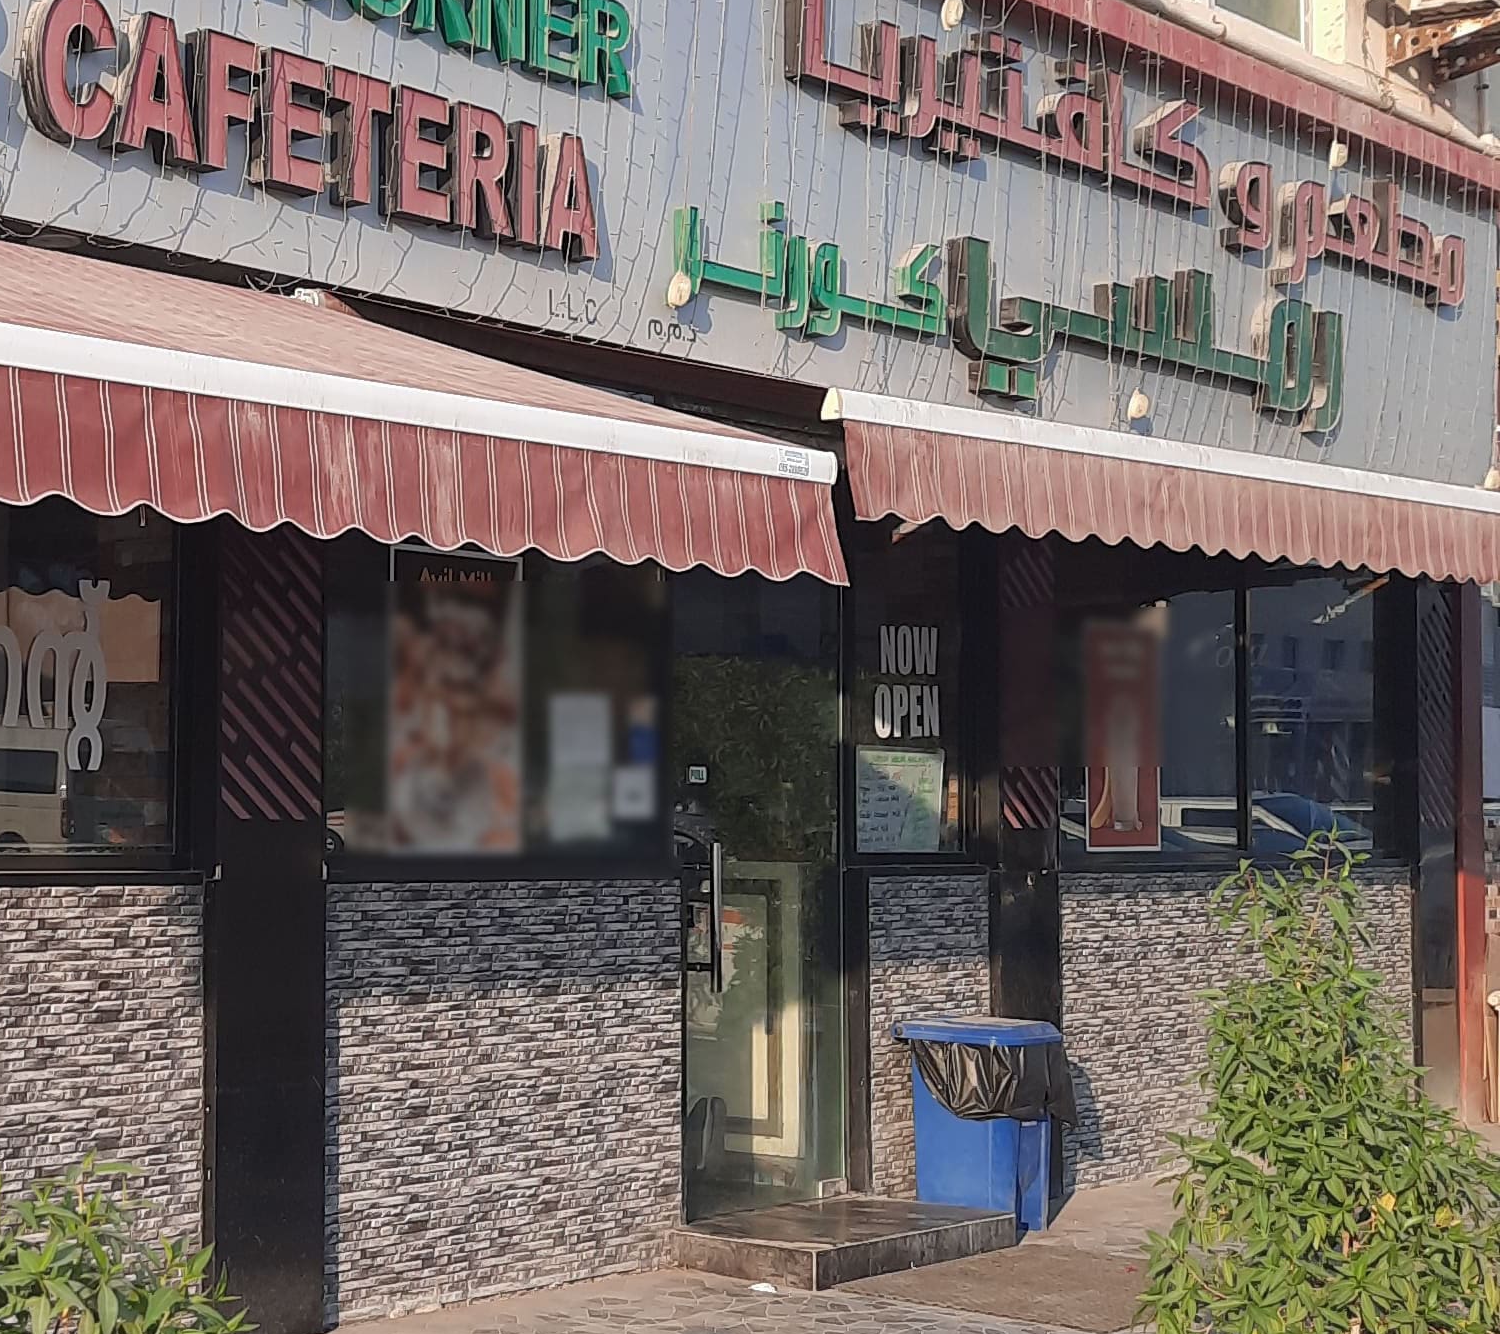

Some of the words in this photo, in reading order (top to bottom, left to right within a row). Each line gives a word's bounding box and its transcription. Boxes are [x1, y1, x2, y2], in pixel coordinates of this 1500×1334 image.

[1268, 179, 1466, 307] مطعم
[880, 625, 938, 675] NOW
[874, 683, 940, 739] OPEN
